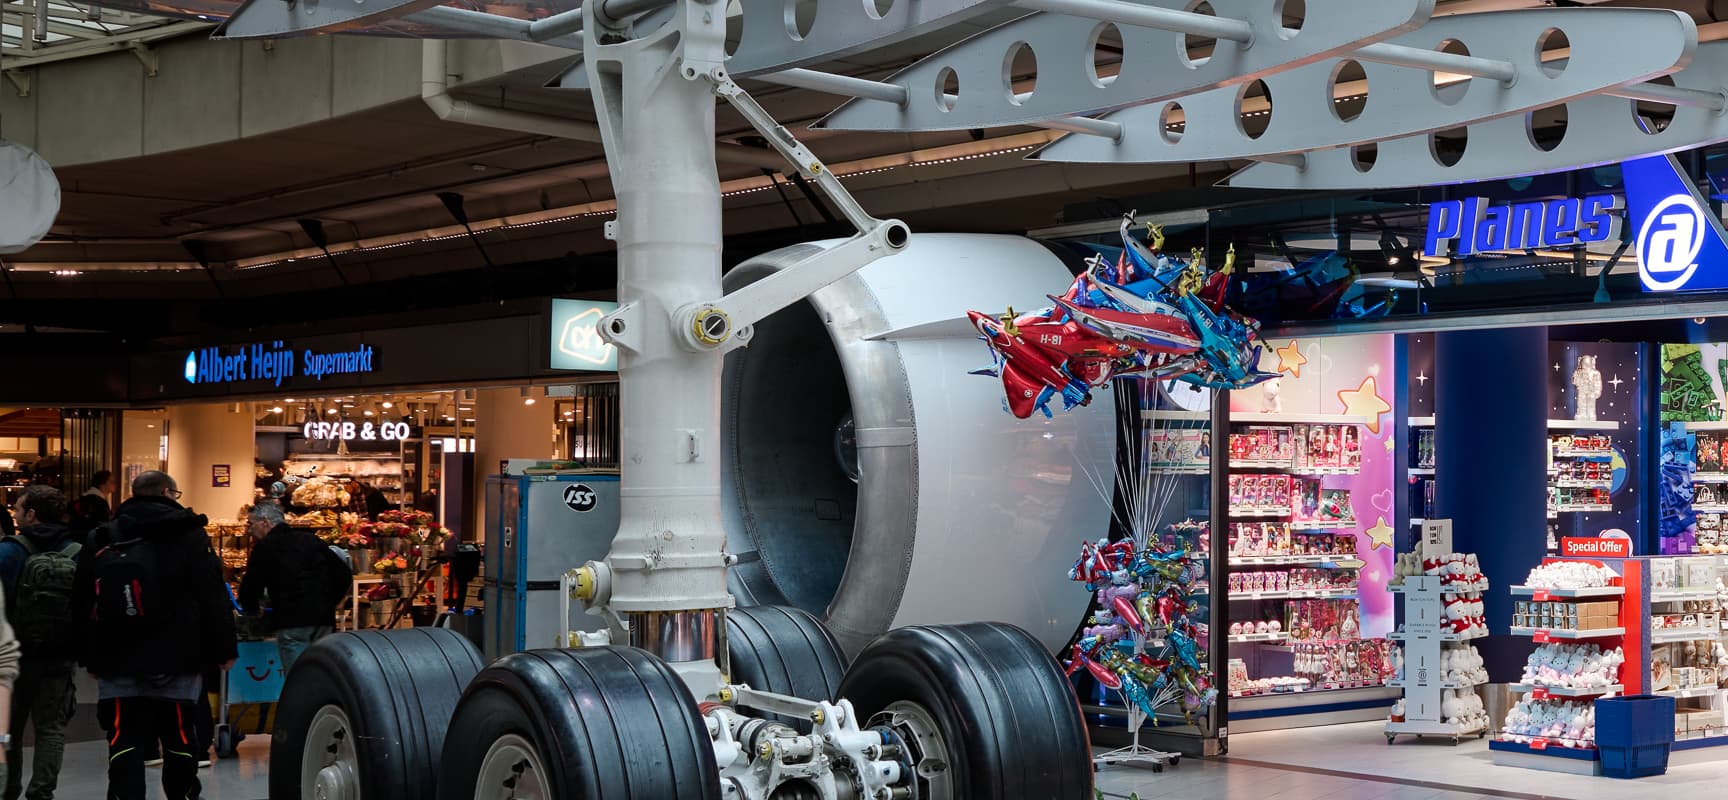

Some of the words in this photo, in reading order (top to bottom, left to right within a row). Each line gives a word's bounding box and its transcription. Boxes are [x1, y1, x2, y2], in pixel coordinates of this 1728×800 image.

[1424, 194, 1616, 257] Planes
[198, 346, 246, 383] Albert
[251, 340, 294, 387] Heijn
[303, 343, 373, 380] Supermarkt
[303, 422, 356, 440] GRAB
[361, 422, 376, 440] &
[381, 422, 410, 440] GO
[566, 490, 594, 505] ISS
[1567, 541, 1599, 553] Special
[1600, 541, 1623, 552] Offer
